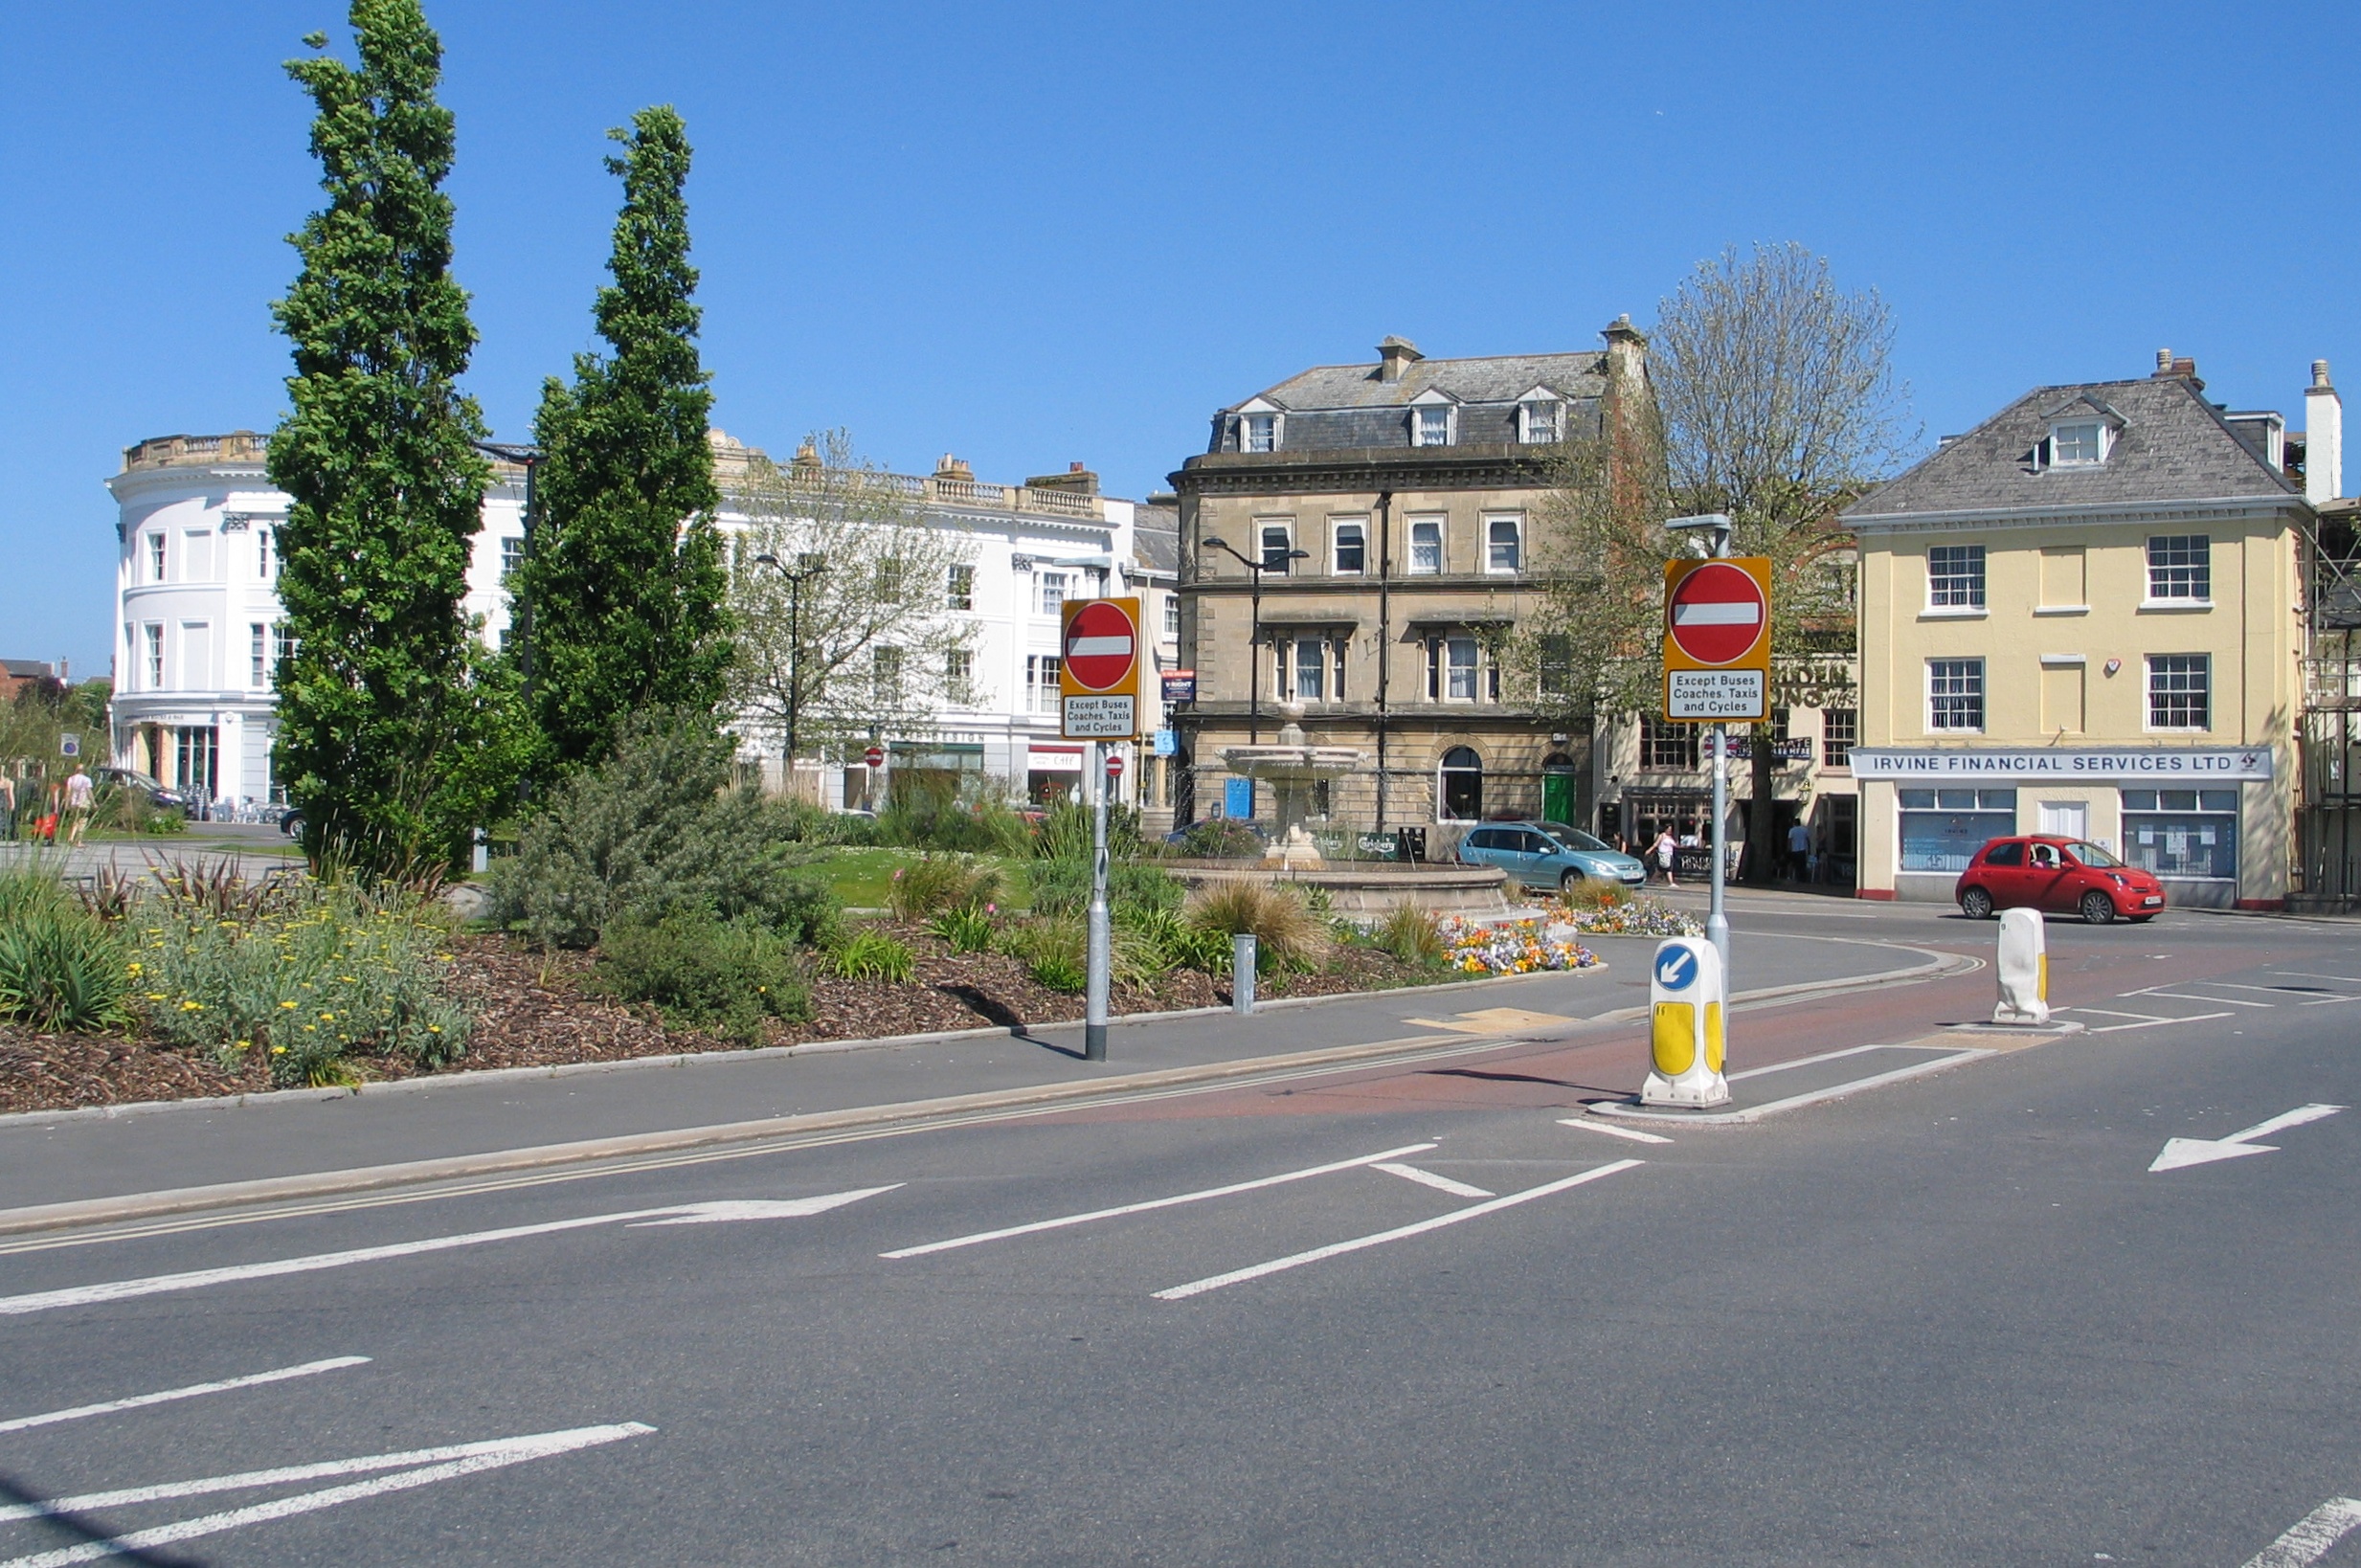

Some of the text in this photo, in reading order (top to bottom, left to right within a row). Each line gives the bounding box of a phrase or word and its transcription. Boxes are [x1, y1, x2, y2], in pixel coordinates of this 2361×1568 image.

[1676, 675, 1755, 687] Except Buses
[1728, 687, 1758, 699] Taxis
[1069, 699, 1128, 710] Except Buses
[1684, 700, 1747, 713] and Cycles
[1108, 710, 1130, 720] Taxis
[1075, 722, 1122, 733] and Cycles
[932, 732, 985, 743] DESIGN
[1874, 756, 2231, 770] IRVINE FINANCIAL SERVICES LTD
[1358, 836, 1396, 854] Carlsberg
